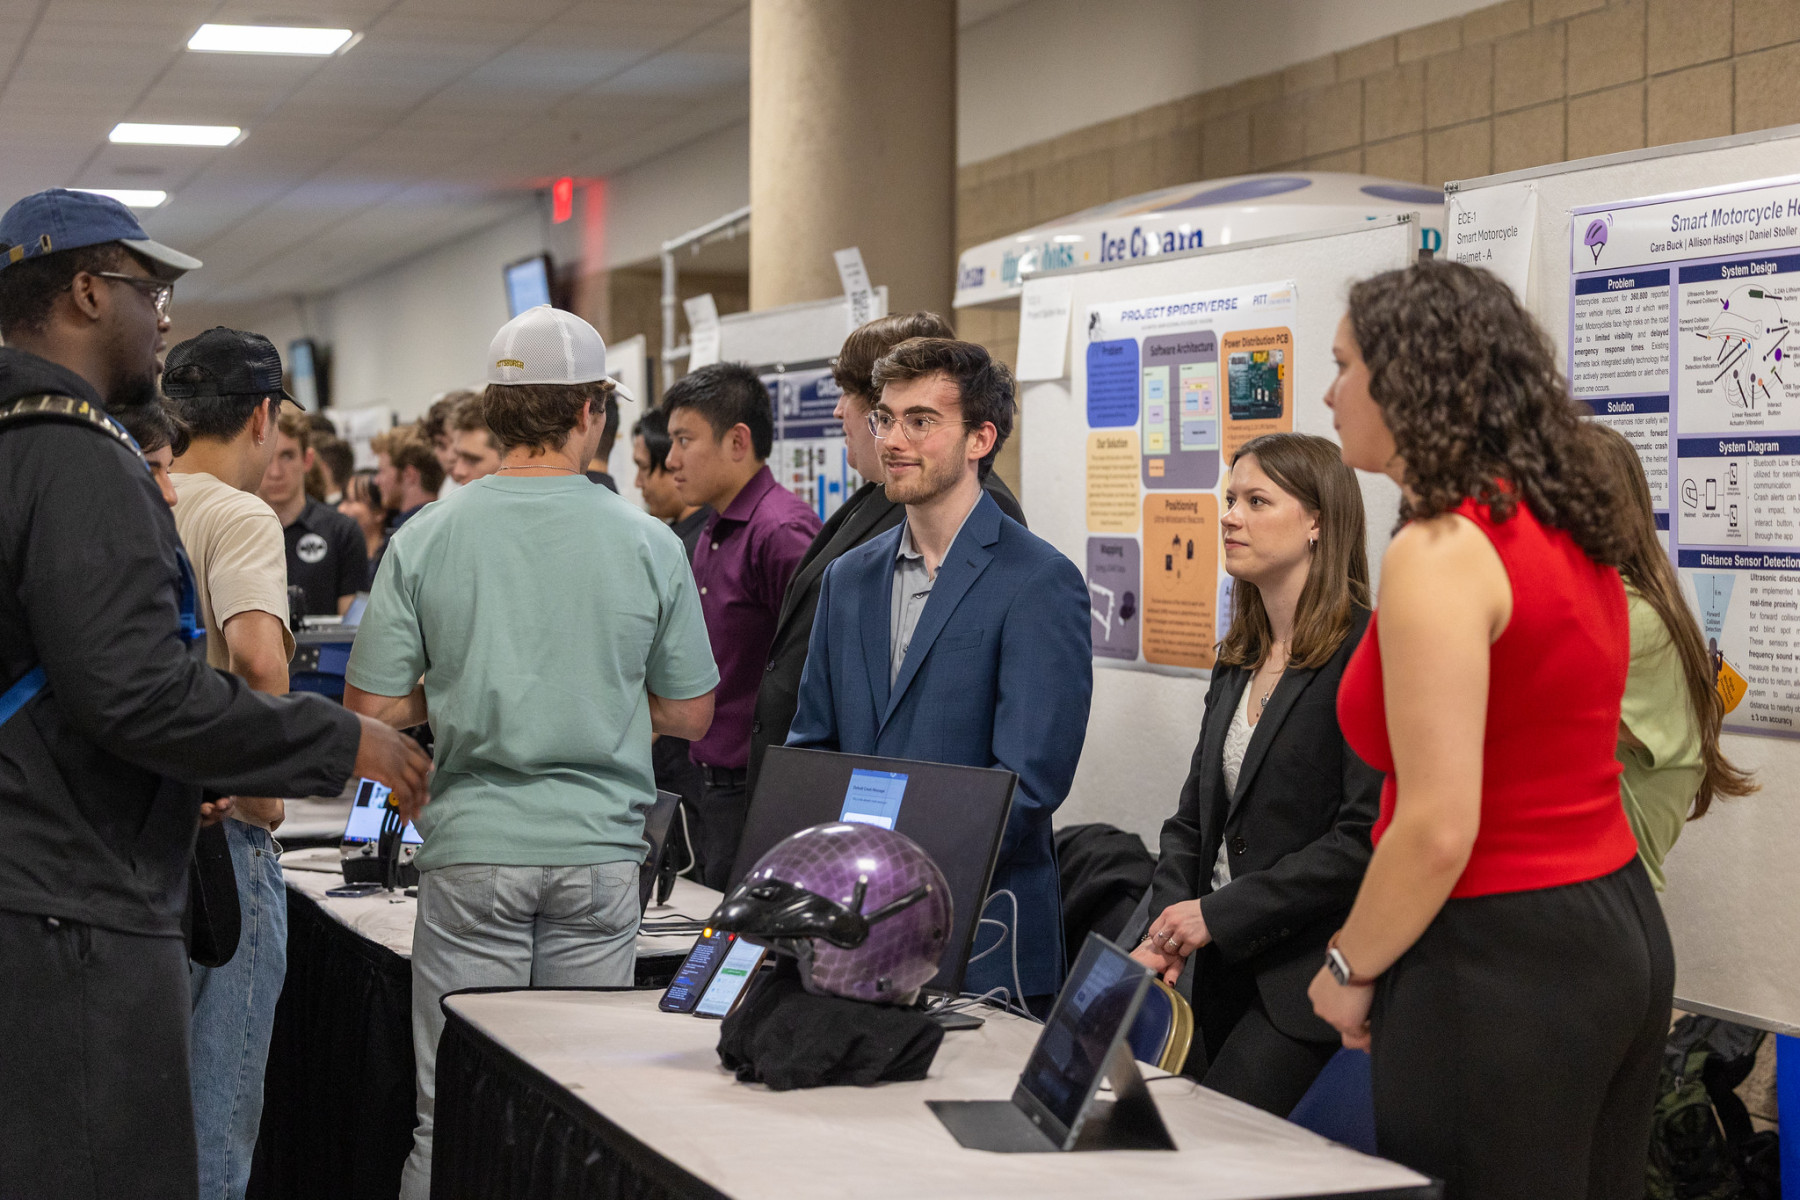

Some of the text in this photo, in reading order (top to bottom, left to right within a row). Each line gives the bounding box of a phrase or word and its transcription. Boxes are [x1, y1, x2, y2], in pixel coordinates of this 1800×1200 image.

[1457, 211, 1476, 225] ECE-1
[1671, 212, 1708, 232] Smart
[1711, 201, 1783, 228] Motorcycle
[1457, 232, 1477, 244] Smart
[1478, 225, 1518, 241] Motorcycle
[1650, 226, 1797, 252] Cara Buck Allison Hastings Daniel Stoller
[1100, 231, 1126, 264] Ice
[1456, 248, 1492, 264] Helmet A
[1722, 261, 1777, 279] System Design
[1608, 278, 1635, 289] Problem
[1576, 297, 1599, 306] Motorcycles
[1651, 290, 1669, 298] reported
[1120, 297, 1238, 322] PROJECT SPIDERVERSE
[1625, 306, 1633, 314] 233
[1585, 321, 1612, 330] Motorcyclists
[1623, 319, 1632, 328] high
[1224, 333, 1288, 348] Power Distribution PCB
[1595, 334, 1610, 342] limited
[1615, 332, 1633, 340] visibility
[1651, 329, 1669, 338] delayed
[1150, 342, 1214, 356] Software Architecture
[1575, 342, 1669, 356] emergency response Existing
[1601, 358, 1621, 367] integrated
[1622, 357, 1635, 366] safety
[1636, 356, 1659, 364] technology
[1583, 372, 1599, 380] actively
[1600, 371, 1616, 379] prevent
[1617, 370, 1637, 378] accidents
[1608, 401, 1634, 412] Solution
[1645, 417, 1658, 425] safety
[1719, 440, 1779, 455] System Diagram
[1754, 459, 1776, 467] Bluetooth
[1754, 493, 1769, 501] Crash
[1777, 520, 1794, 528] button,
[1755, 532, 1773, 541] through
[1701, 554, 1800, 568] Distance Sensor Detection
[1750, 573, 1776, 581] Ultrasonic
[1762, 587, 1793, 595] implemented
[1750, 599, 1798, 610] real-time proximity
[1760, 612, 1778, 620] forward
[1764, 625, 1775, 633] blind
[1781, 627, 1791, 635] spot
[1749, 636, 1788, 647] These sensors
[1749, 650, 1774, 661] frequency
[1749, 664, 1769, 672] measure
[1757, 676, 1769, 684] echo
[1770, 677, 1775, 685] to
[1749, 689, 1766, 697] system
[1750, 701, 1769, 710] distance
[1777, 704, 1793, 714] nearby
[1769, 716, 1792, 726] accuracy
